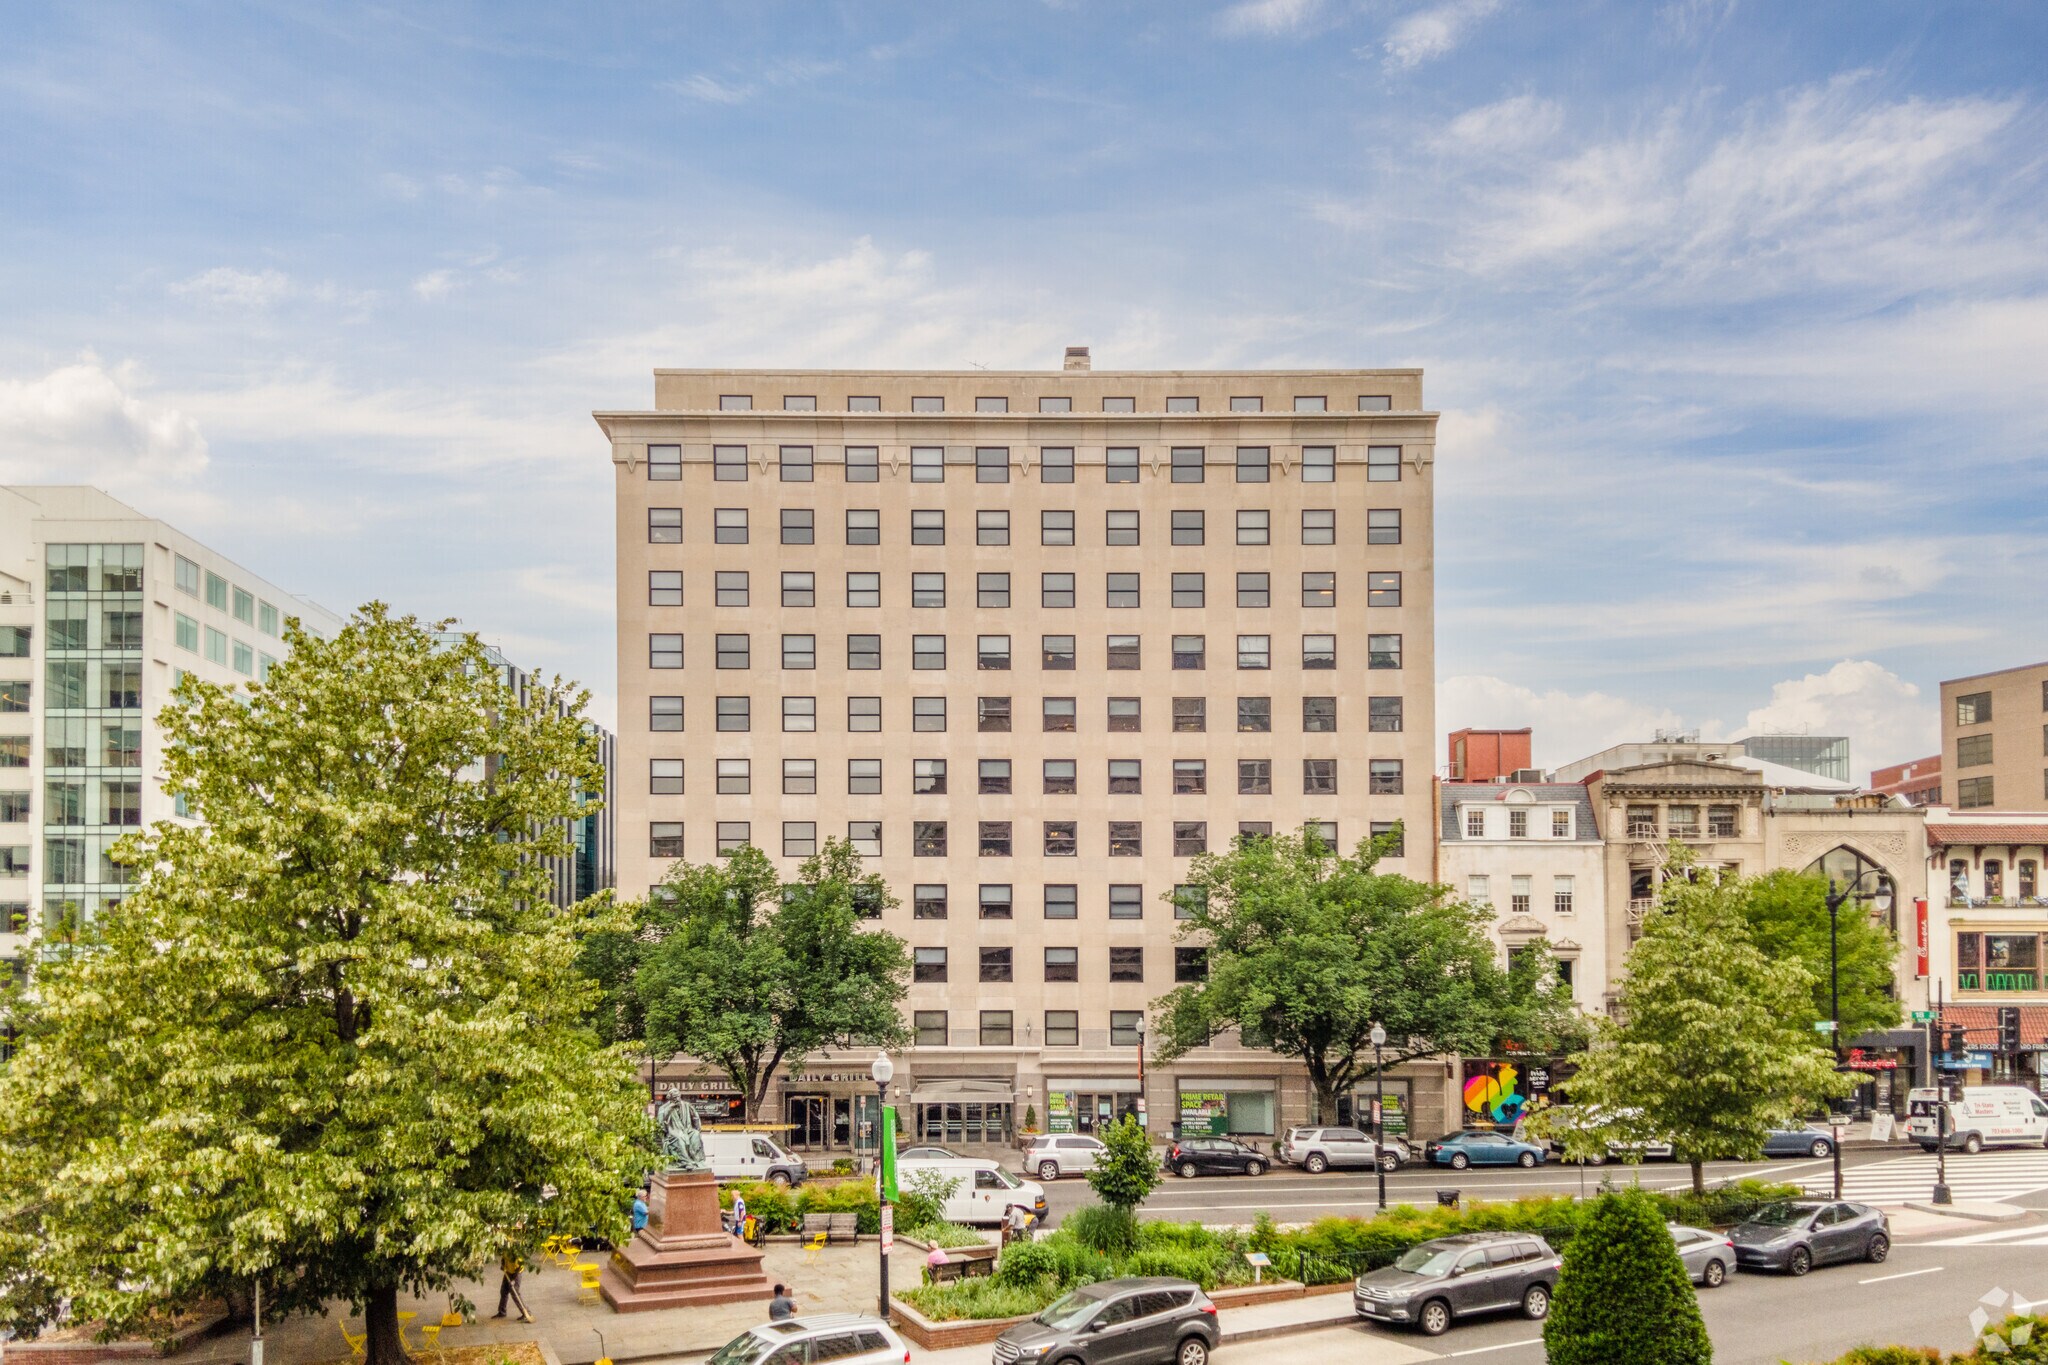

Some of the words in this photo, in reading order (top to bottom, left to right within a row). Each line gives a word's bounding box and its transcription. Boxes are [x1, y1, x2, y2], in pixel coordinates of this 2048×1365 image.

[831, 1073, 869, 1082] GRILL
[660, 1082, 695, 1091] DAILY
[1181, 1092, 1202, 1101] PRIME
[1203, 1093, 1224, 1101] RETAIL
[1181, 1100, 1202, 1109] SPACE
